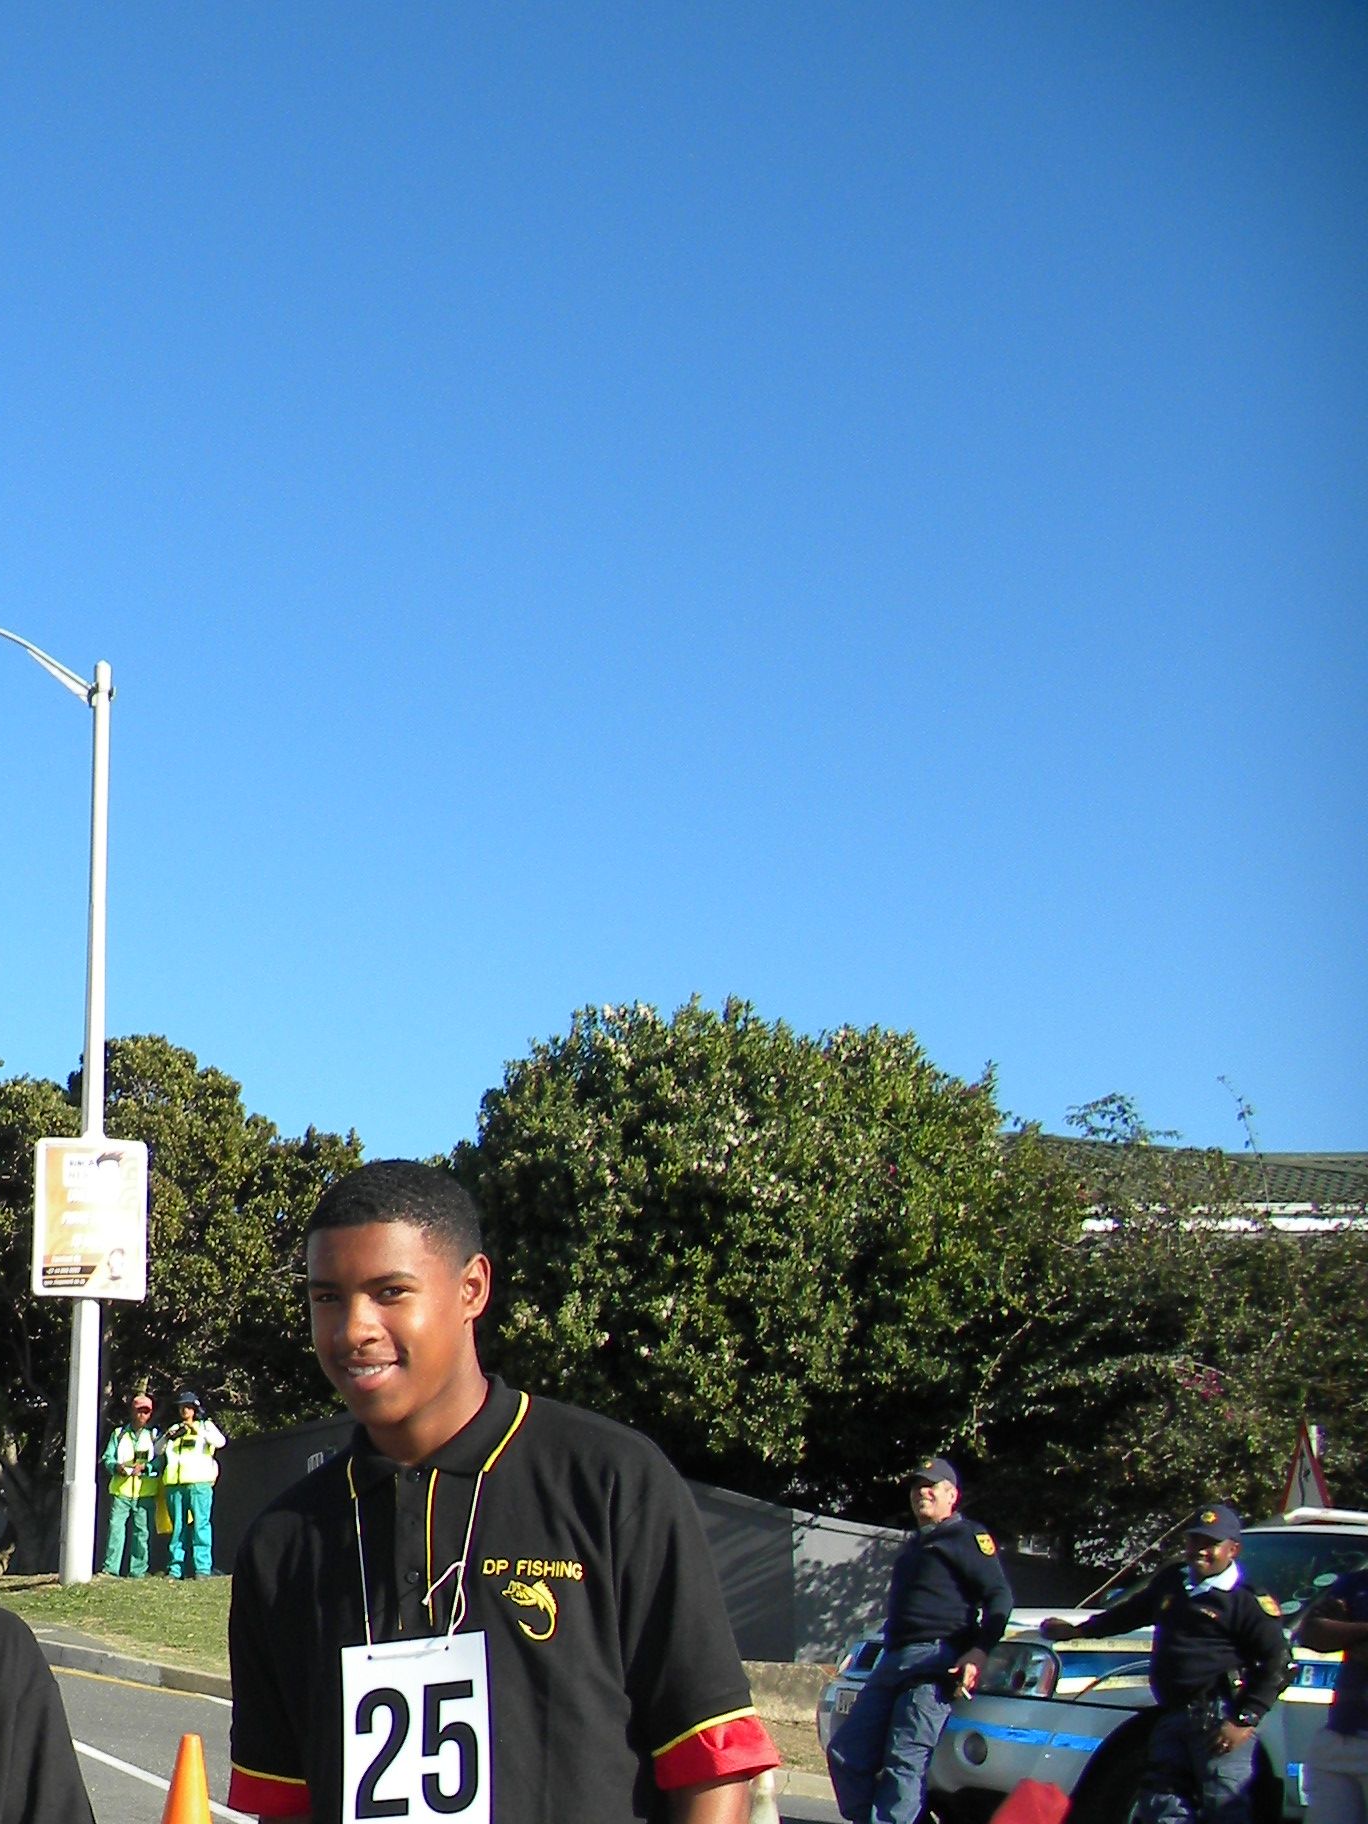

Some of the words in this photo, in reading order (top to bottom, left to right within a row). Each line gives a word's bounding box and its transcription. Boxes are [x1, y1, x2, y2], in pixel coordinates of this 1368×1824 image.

[482, 1558, 509, 1576] DP
[516, 1559, 583, 1581] FISHING
[354, 1679, 479, 1820] 25
